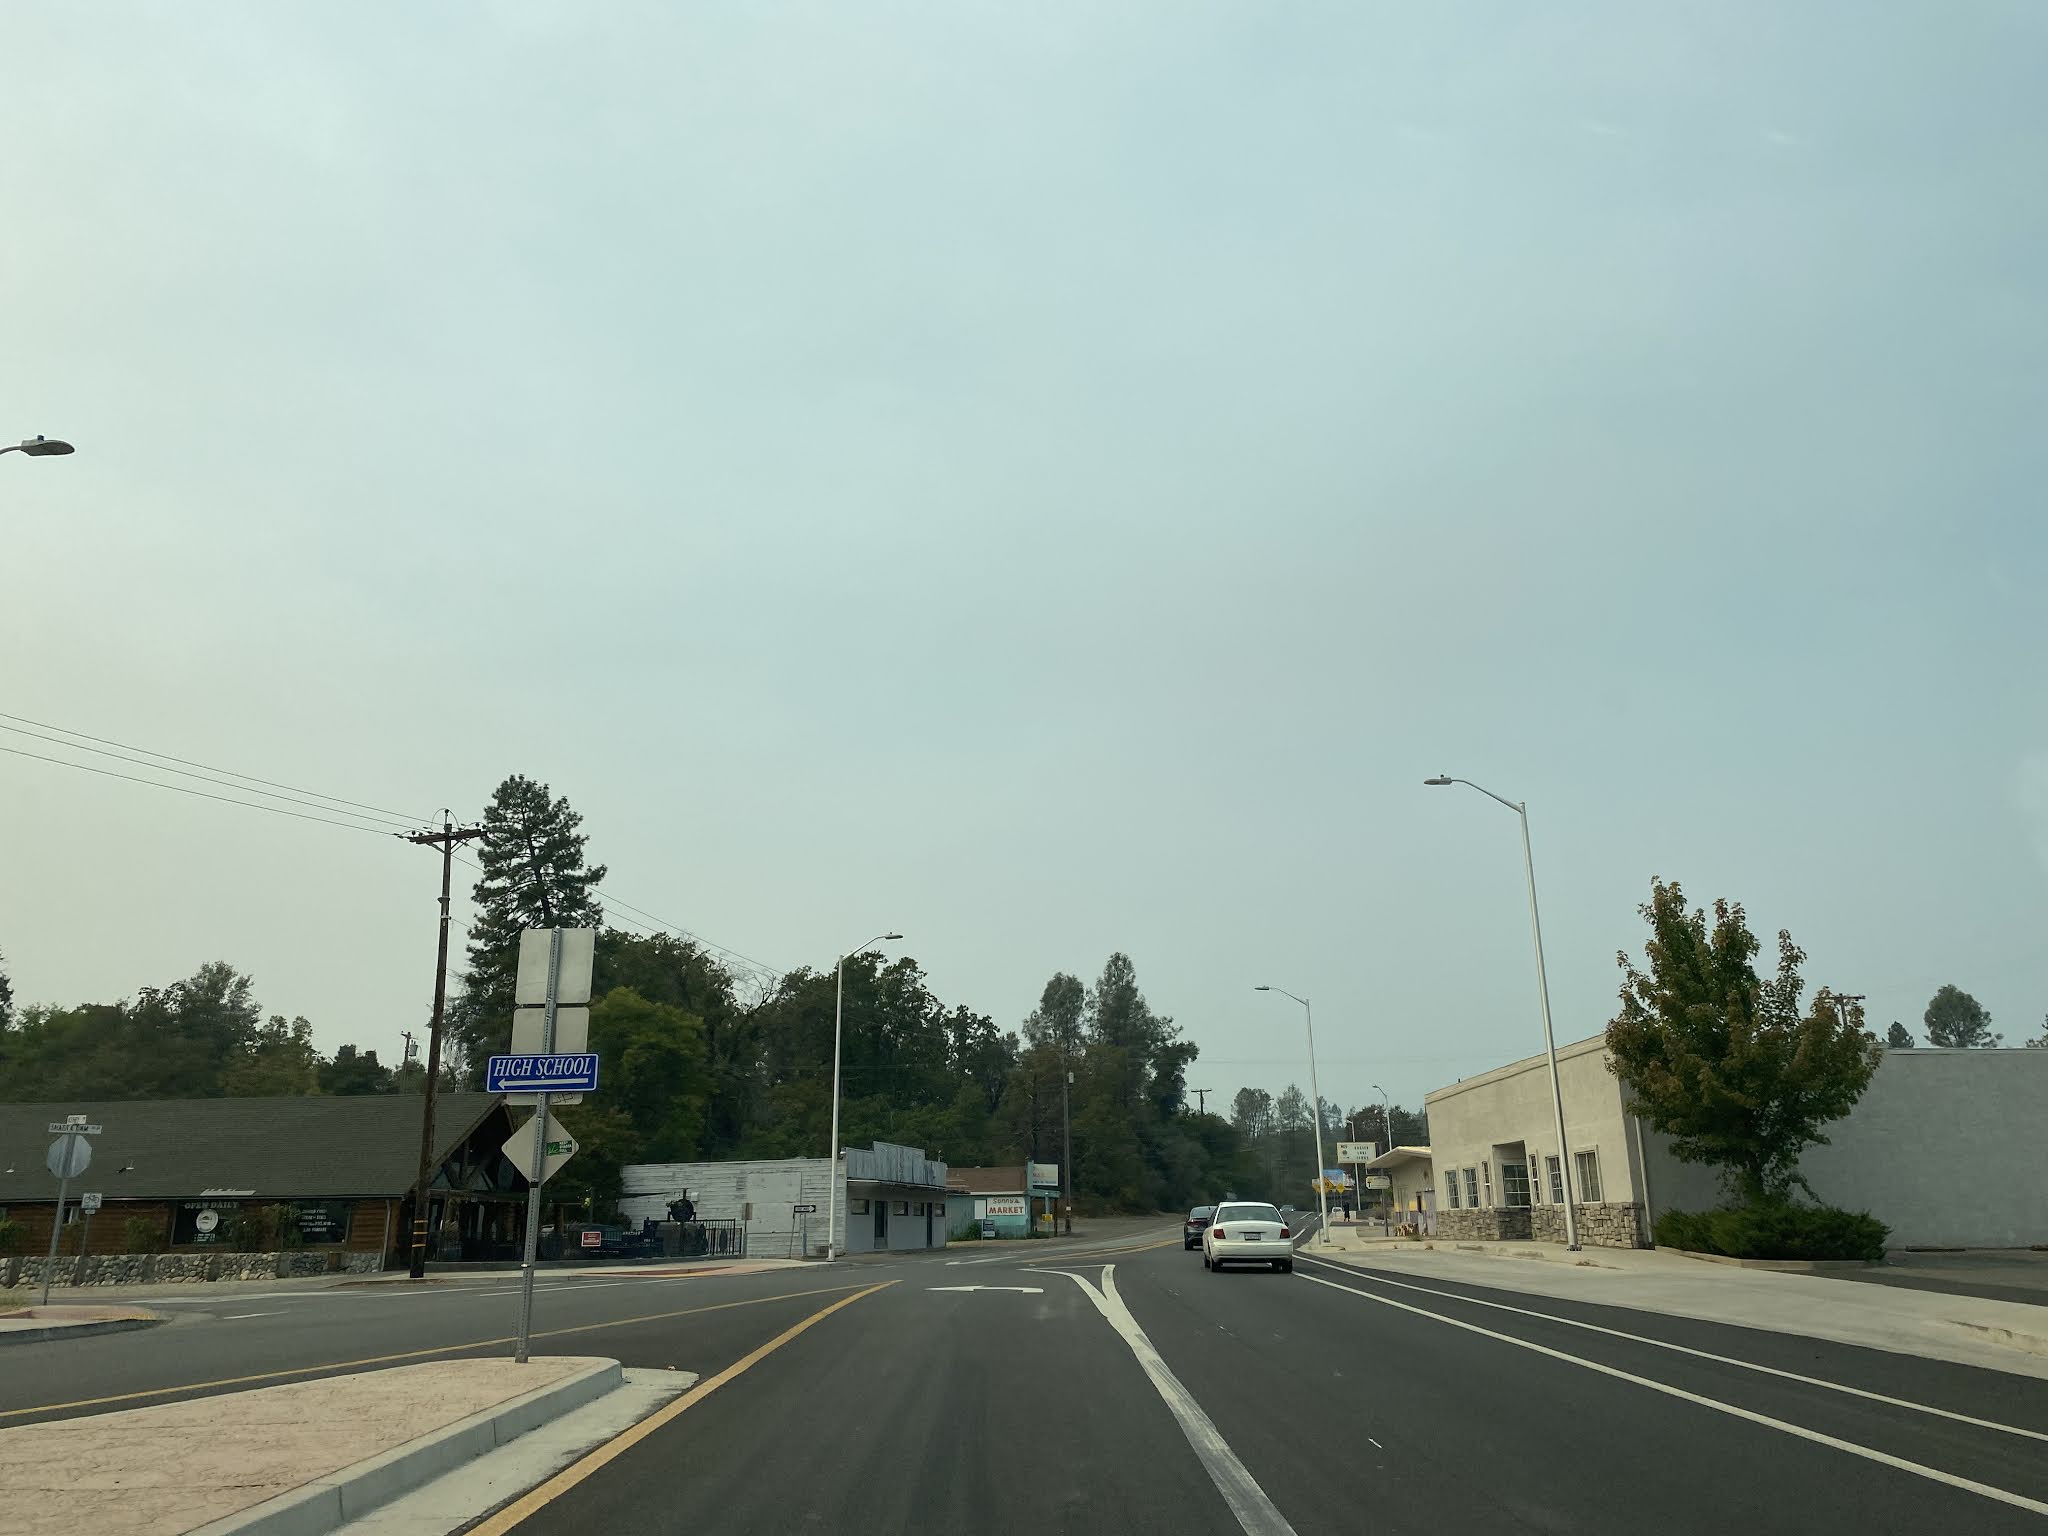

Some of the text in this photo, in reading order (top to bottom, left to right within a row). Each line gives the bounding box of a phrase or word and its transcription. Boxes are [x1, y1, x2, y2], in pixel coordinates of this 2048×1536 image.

[494, 1057, 592, 1077] HIGH SCHOOL
[988, 1206, 1024, 1214] MARKET
